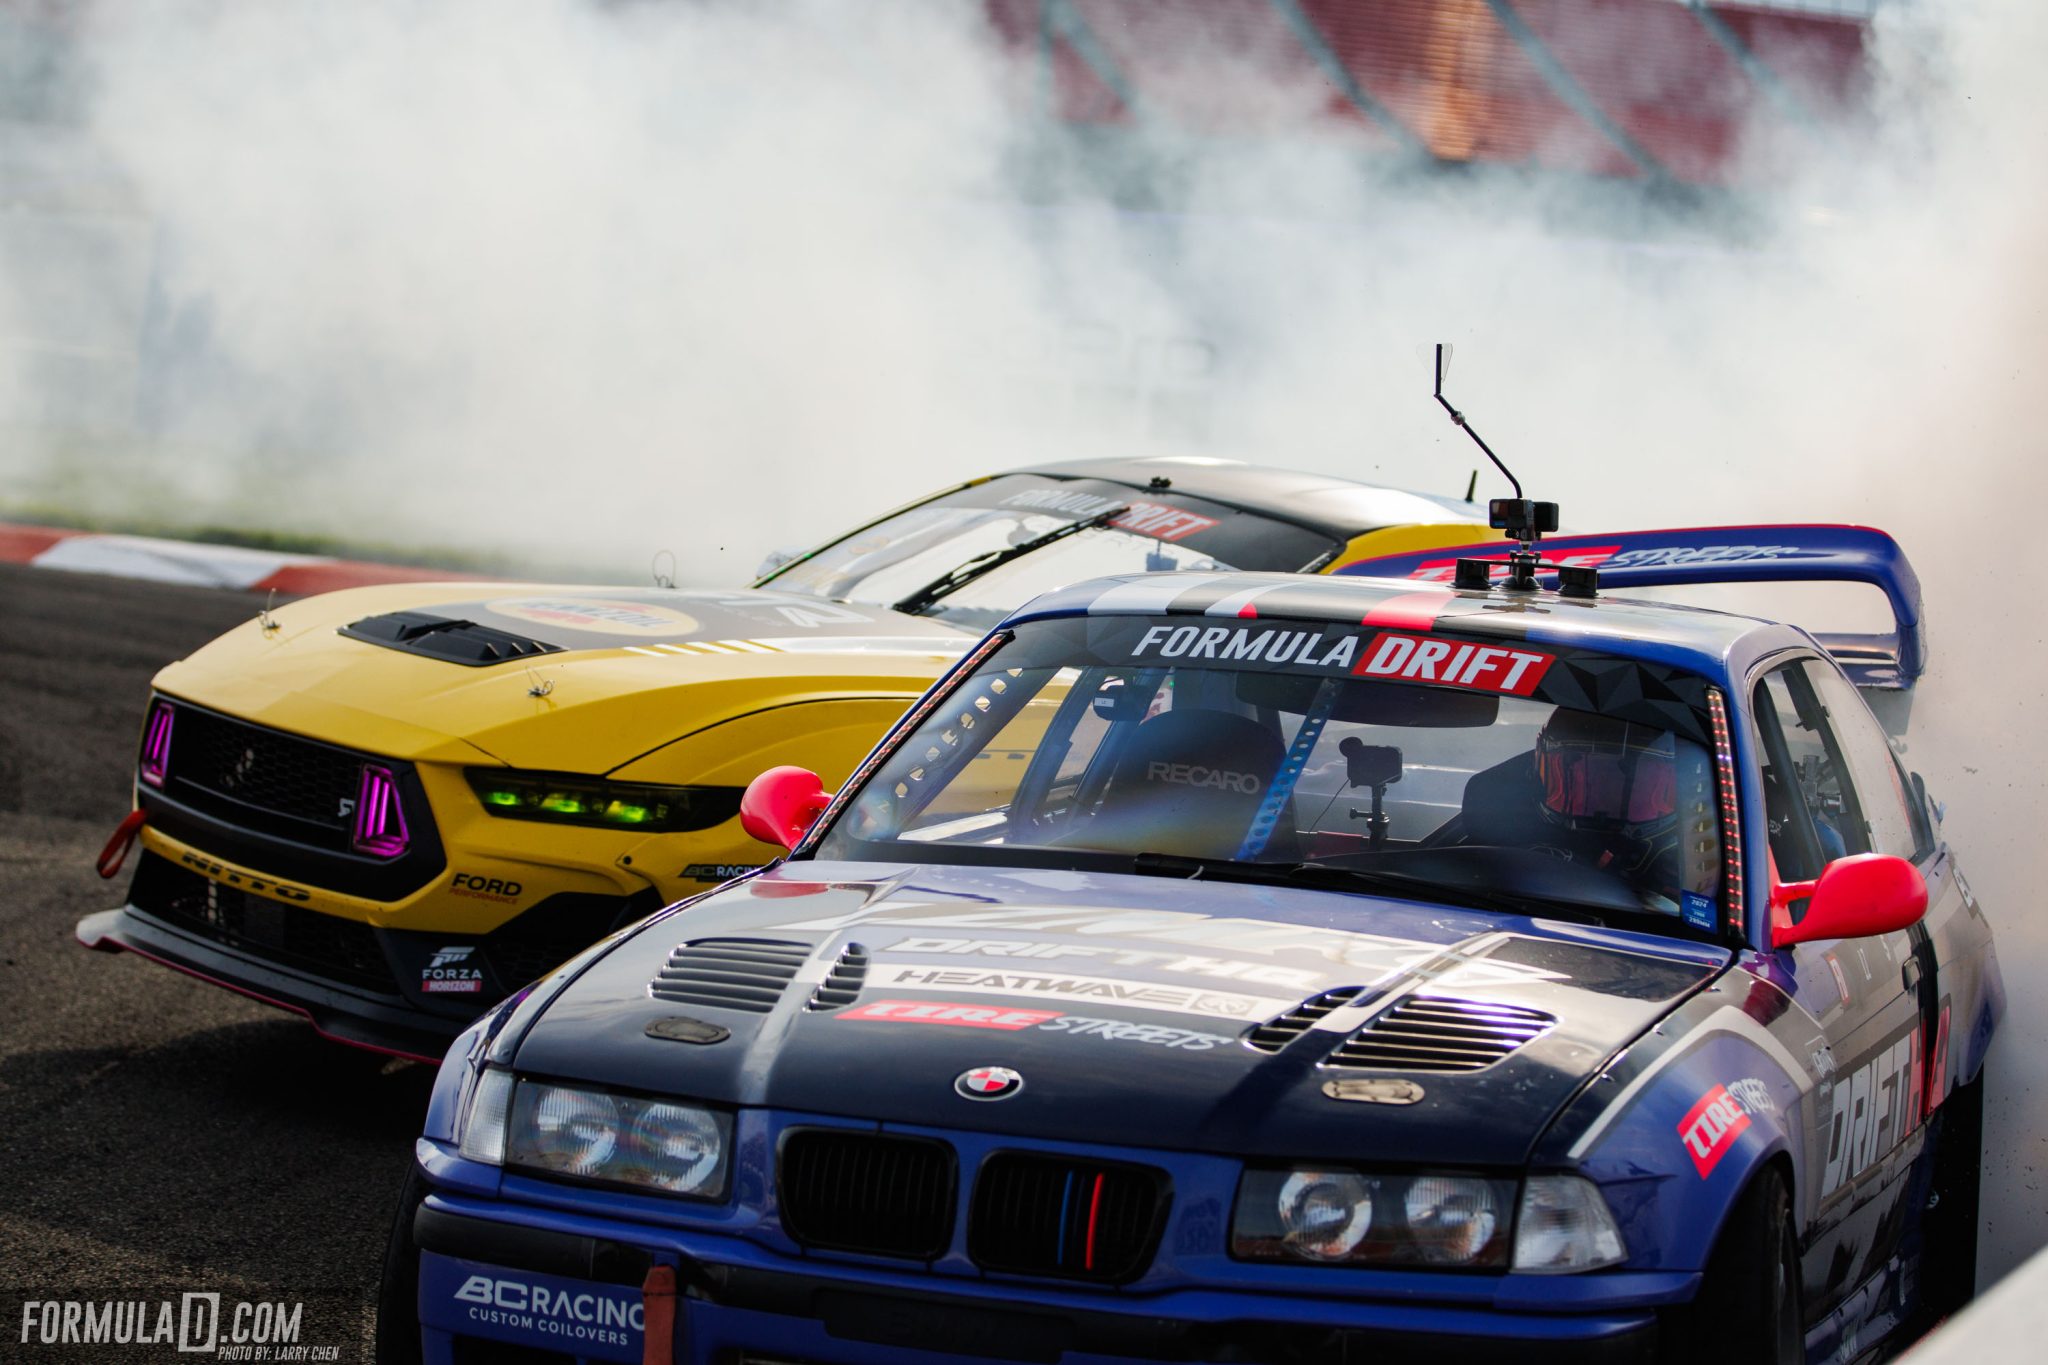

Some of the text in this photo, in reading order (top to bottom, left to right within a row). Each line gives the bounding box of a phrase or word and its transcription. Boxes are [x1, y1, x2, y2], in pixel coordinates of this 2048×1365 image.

[1600, 545, 1800, 572] STREETS
[1131, 626, 1543, 691] FORMULA DRIFT
[1147, 761, 1261, 795] RECARO
[182, 851, 311, 901] NITTO
[451, 872, 523, 896] FORD
[422, 969, 483, 980] FORZA
[428, 981, 476, 992] HORIZON
[893, 969, 1187, 1006] HEATWAVE
[863, 1003, 1235, 1051] TIRE STREETS
[1682, 1092, 1745, 1159] TIRE
[469, 1307, 628, 1346] CUSTOM COILOVERS
